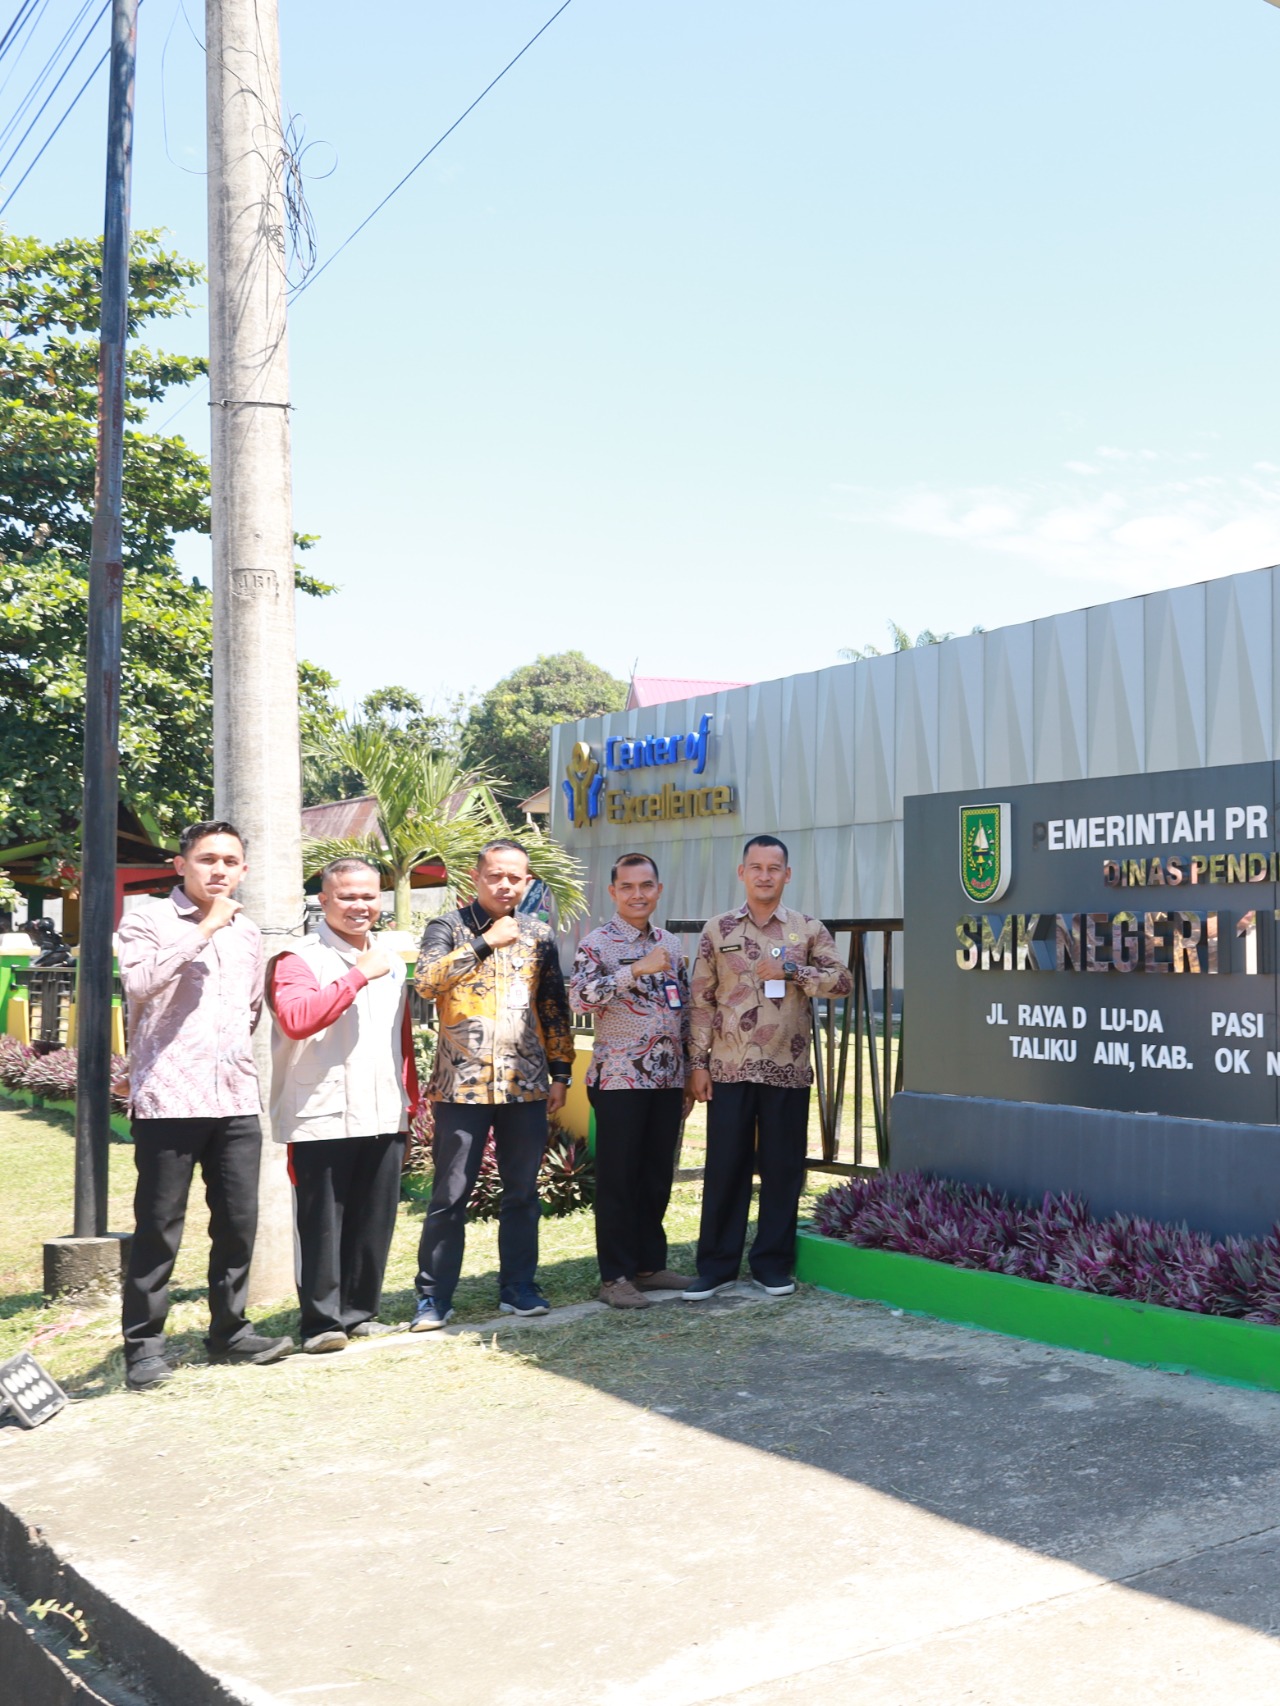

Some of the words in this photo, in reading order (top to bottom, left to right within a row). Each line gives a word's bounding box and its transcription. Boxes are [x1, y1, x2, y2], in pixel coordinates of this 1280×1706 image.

[606, 734, 684, 771] Center
[685, 712, 713, 775] of
[606, 783, 732, 824] Excellence
[1103, 855, 1184, 889] DINAS
[955, 912, 1042, 971] SMK
[1055, 910, 1220, 975] NEGERI
[1236, 909, 1258, 975] 1
[1017, 1004, 1068, 1029] RAYA
[1141, 1043, 1194, 1070] KAB.
